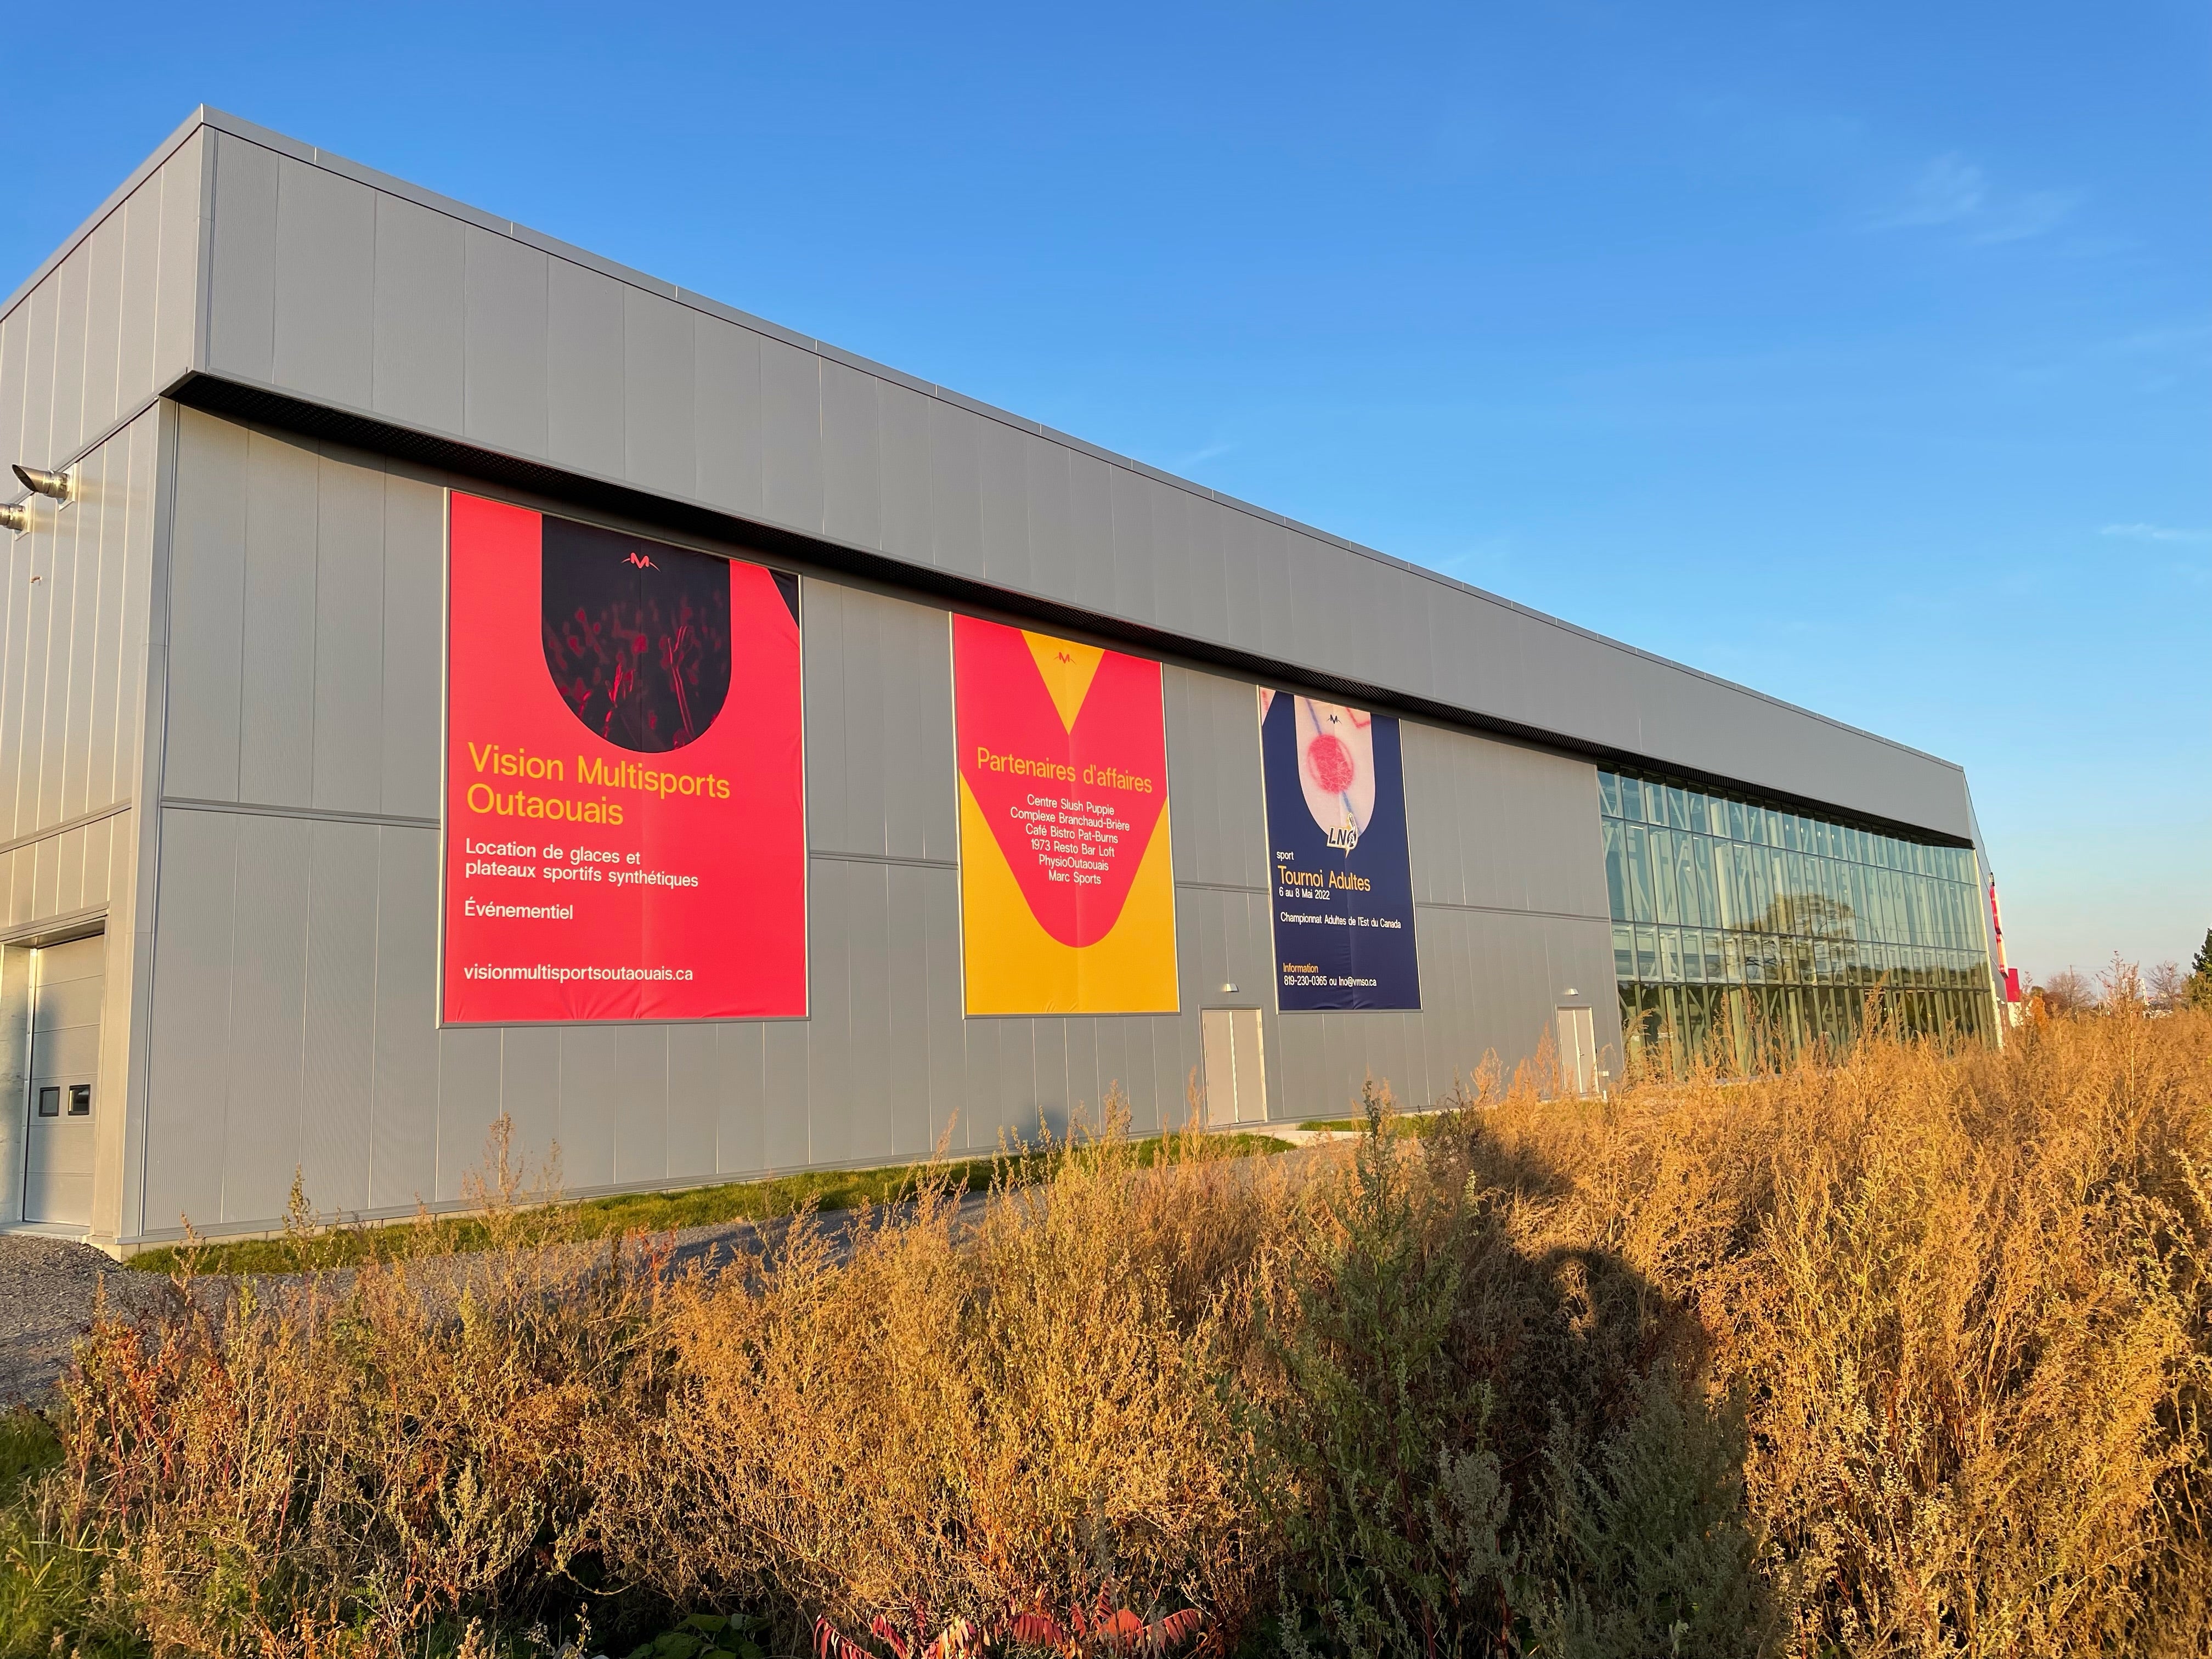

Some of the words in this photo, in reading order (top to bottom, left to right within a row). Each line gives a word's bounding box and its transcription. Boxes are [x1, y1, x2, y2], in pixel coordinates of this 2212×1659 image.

[468, 742, 563, 781] Vision
[578, 755, 731, 799] Multisports
[977, 747, 1076, 782] Partenaires
[1083, 764, 1153, 793] d'affaires
[466, 783, 624, 826] Outaouais
[1027, 794, 1058, 809] Centre
[1060, 799, 1084, 812] Slush
[1086, 802, 1115, 816] Puppie
[1010, 807, 1056, 823] Complexe
[1059, 812, 1130, 832] Branchaud-Brière
[1025, 823, 1047, 837] Café
[1050, 826, 1075, 840] Bistro
[1078, 829, 1119, 844] Pat-Burns
[465, 838, 537, 859] Location
[543, 844, 563, 860] de
[569, 847, 620, 866] glaces
[626, 851, 641, 865] et
[1031, 838, 1051, 851] 1973
[1053, 841, 1079, 855] Resto
[1081, 844, 1096, 856] Bar
[1099, 845, 1115, 857] Loft
[1276, 851, 1295, 862] sport
[1039, 854, 1109, 871] PhysioOutaouais
[465, 860, 537, 879] plateaux
[543, 865, 602, 884] sportifs
[608, 870, 699, 890] synthétiques
[1048, 870, 1070, 883] Marc
[1073, 873, 1102, 886] Sports
[1277, 865, 1324, 888] Tournoi
[1328, 870, 1371, 892] Adultes
[1279, 887, 1284, 897] 6
[1285, 889, 1294, 898] au
[1295, 888, 1300, 898] 8
[1302, 888, 1313, 899] Mai
[1314, 889, 1330, 901] 2022
[464, 896, 573, 921] Événementiel
[1280, 911, 1322, 926] Championnat
[1324, 915, 1347, 926] Adultes
[1348, 917, 1356, 926] de
[1357, 917, 1370, 928] l'Est
[1370, 917, 1379, 928] du
[1380, 918, 1402, 929] Canada
[464, 963, 693, 984] visionmultisportsoutaouais.ca
[1283, 962, 1319, 974] Information
[1284, 975, 1327, 986] 819-230-0365
[1329, 978, 1337, 986] ou
